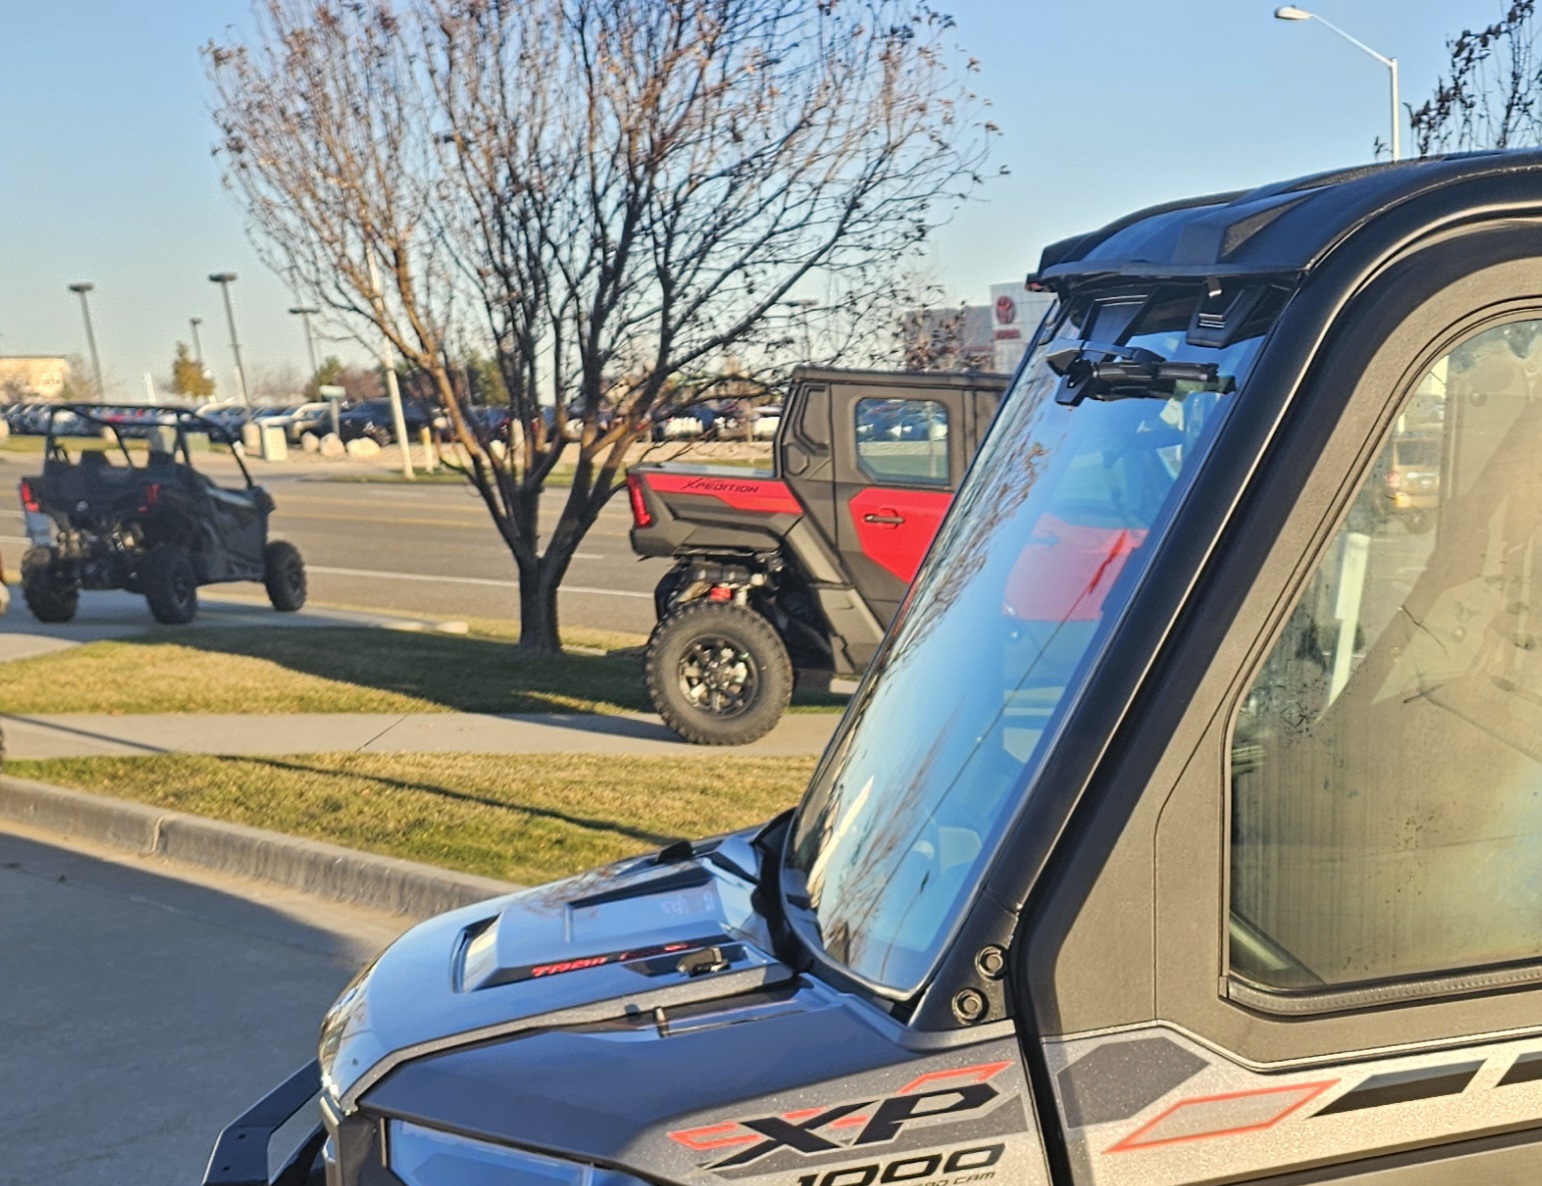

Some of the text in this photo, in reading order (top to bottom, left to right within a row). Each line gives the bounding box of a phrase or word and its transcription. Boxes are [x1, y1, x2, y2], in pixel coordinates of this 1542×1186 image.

[681, 477, 760, 493] XPEDITION
[696, 1082, 1000, 1170] XP
[953, 1171, 996, 1185] CAM
